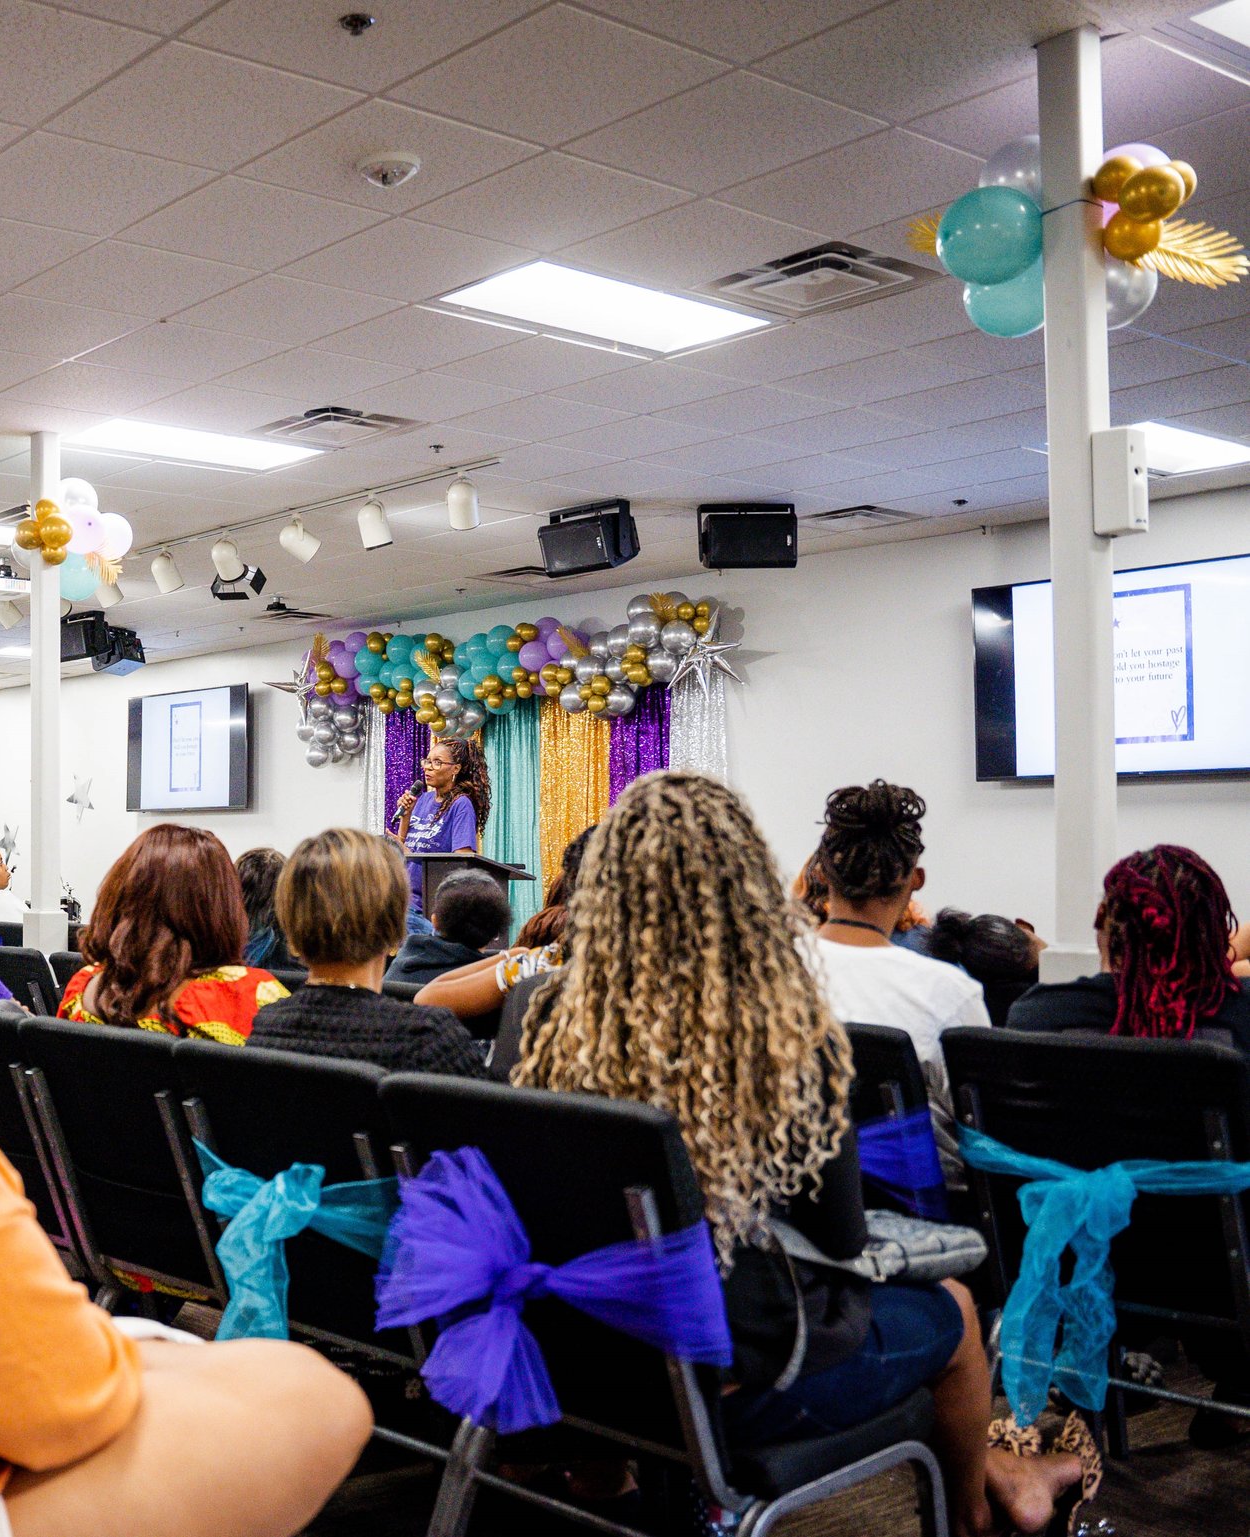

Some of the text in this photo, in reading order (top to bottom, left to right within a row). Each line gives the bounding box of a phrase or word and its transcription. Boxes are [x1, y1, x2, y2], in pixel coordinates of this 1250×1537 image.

[1131, 648, 1141, 658] let
[1143, 649, 1162, 658] your
[1166, 646, 1183, 657] past
[1114, 659, 1180, 671] old you hostage
[1115, 671, 1173, 684] to your future
